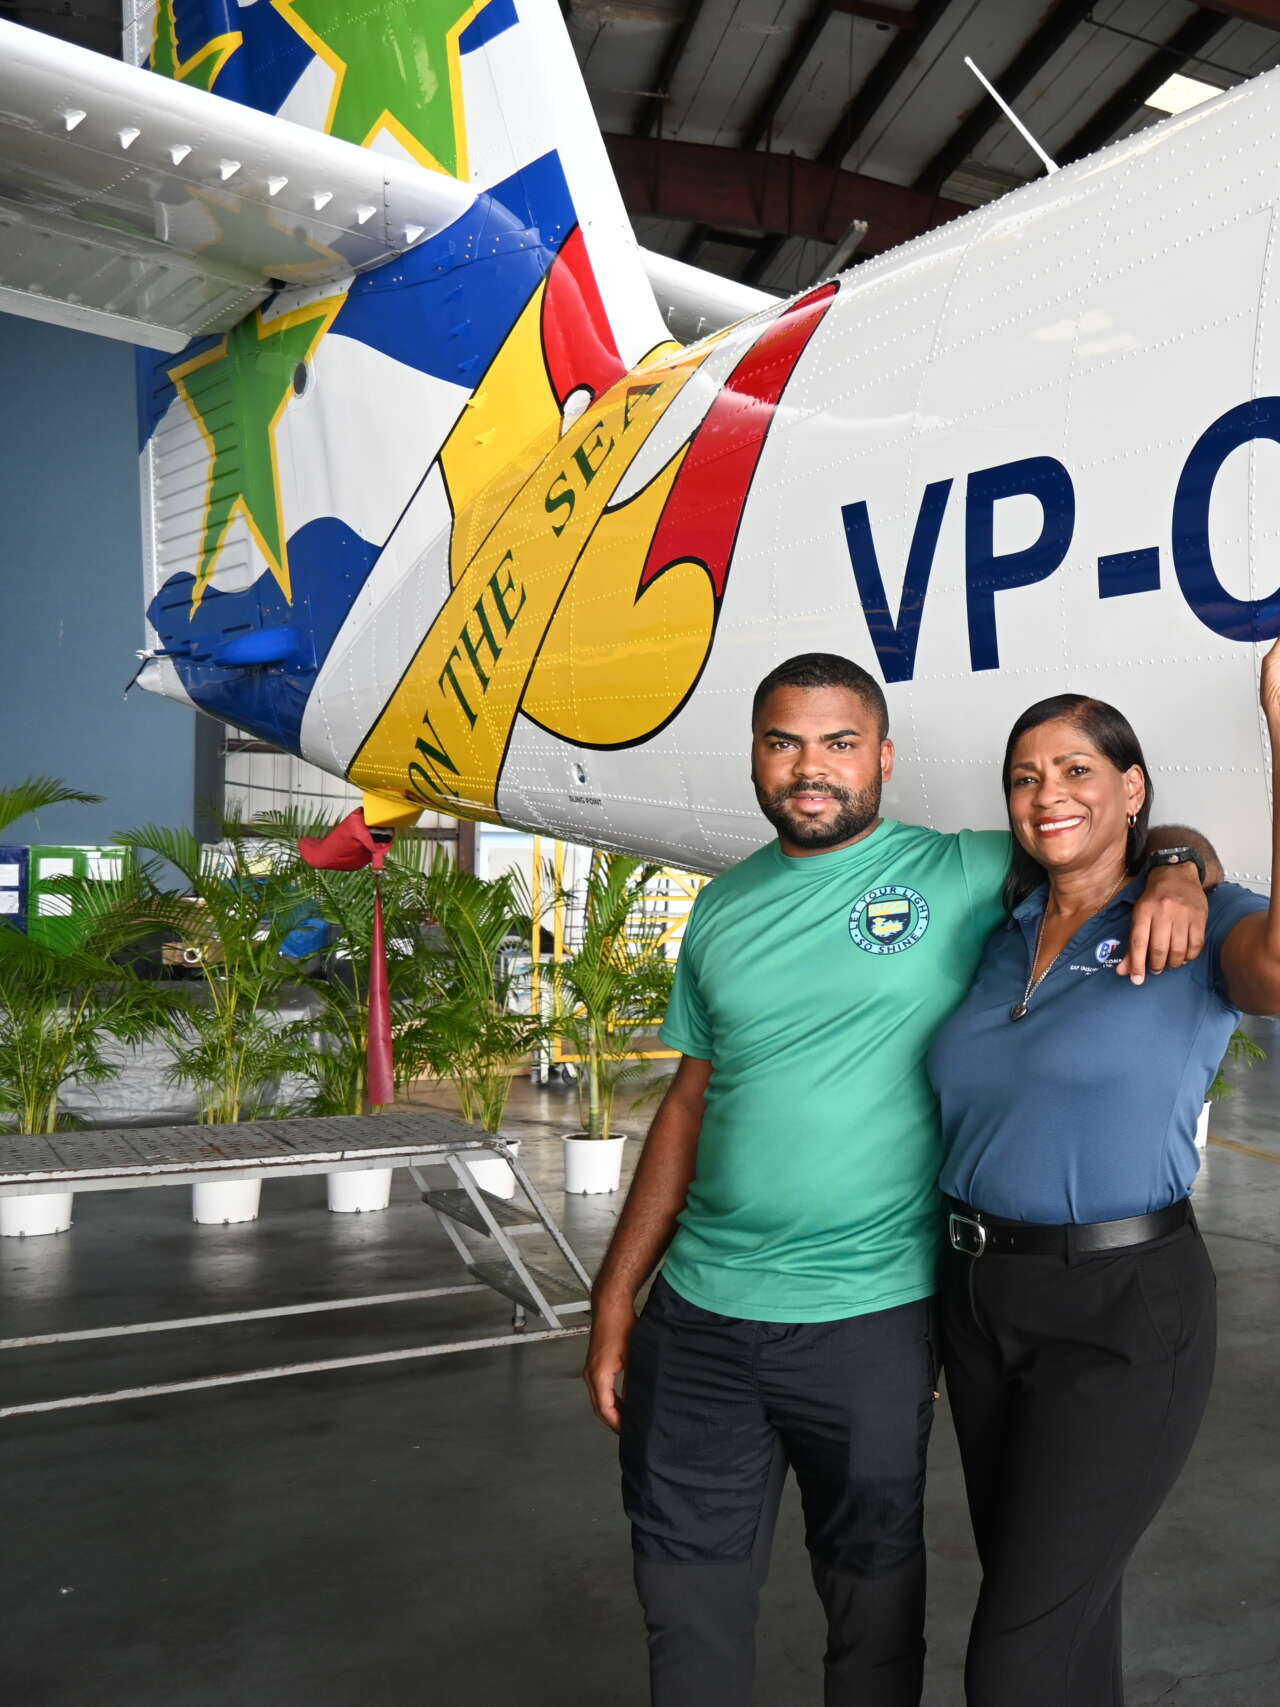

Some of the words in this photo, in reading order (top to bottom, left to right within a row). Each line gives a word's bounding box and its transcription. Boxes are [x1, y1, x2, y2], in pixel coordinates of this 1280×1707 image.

[438, 550, 527, 731] THE
[850, 907, 861, 930] LET
[860, 887, 897, 905] YOUR
[902, 888, 928, 920] LIGHT
[857, 938, 873, 951] SO
[878, 934, 920, 953] SHINE
